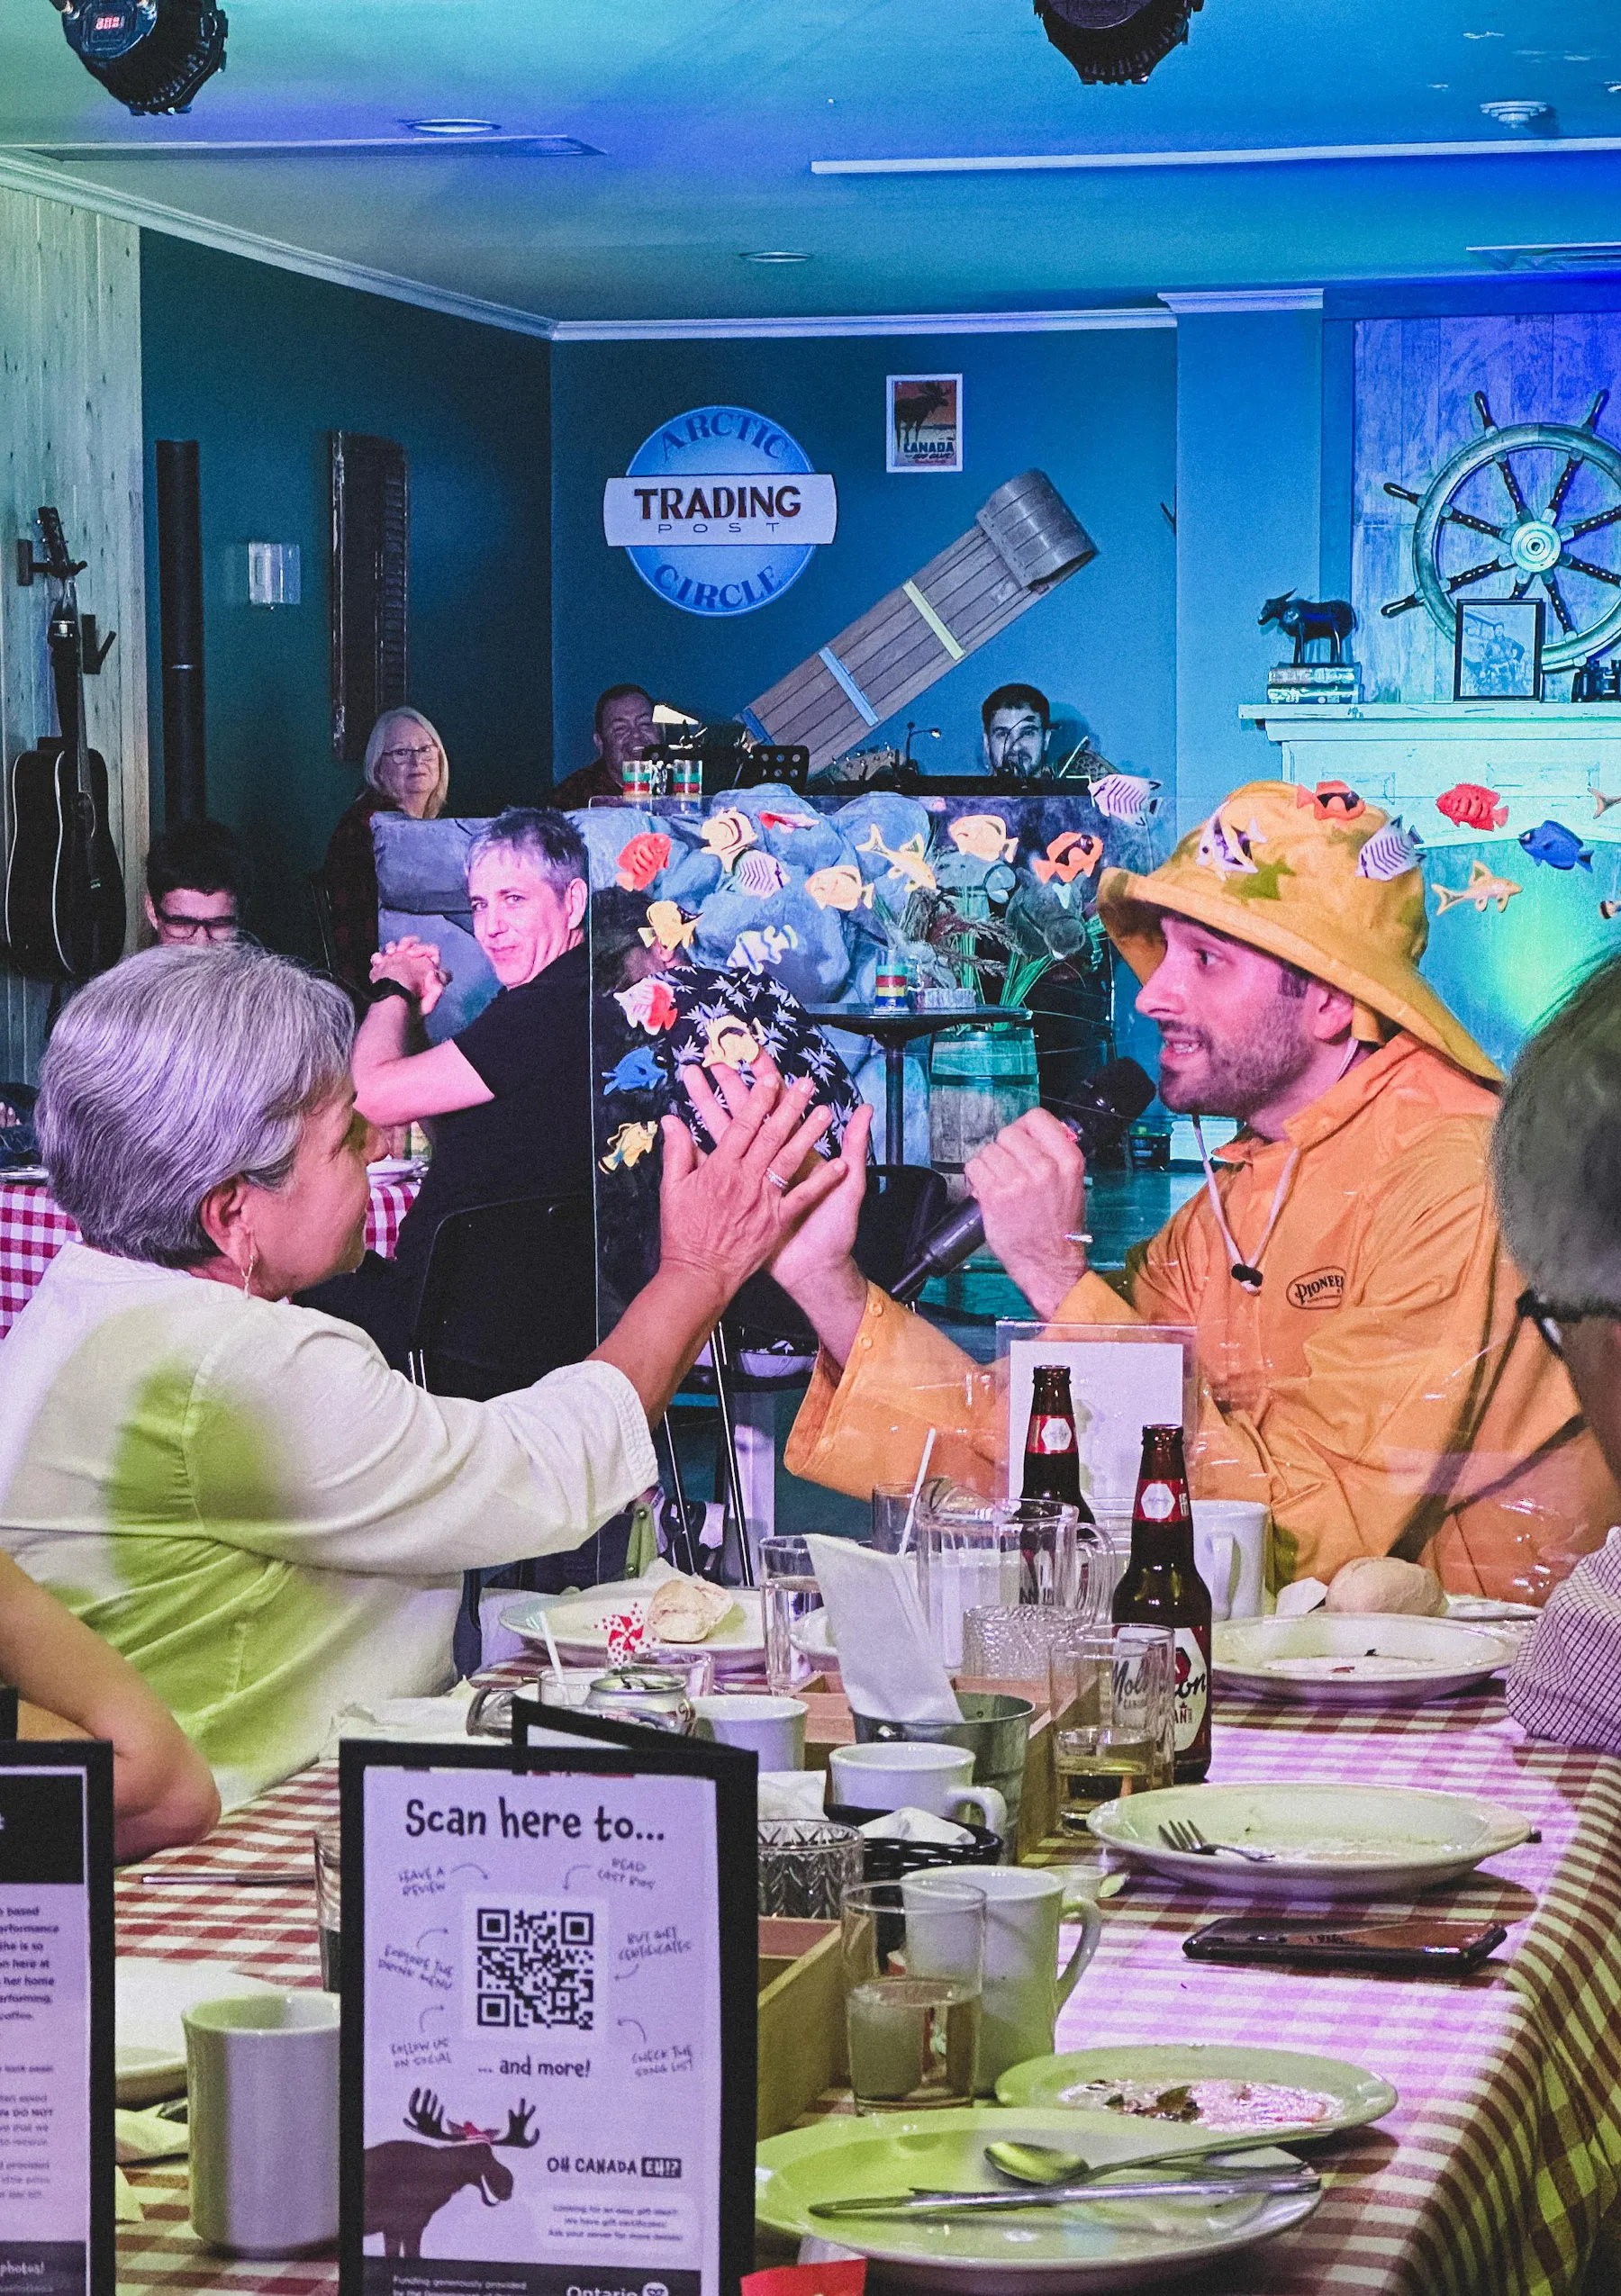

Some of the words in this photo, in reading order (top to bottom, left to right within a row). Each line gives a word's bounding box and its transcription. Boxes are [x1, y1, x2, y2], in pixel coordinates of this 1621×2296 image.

[662, 411, 790, 463] ARCTIC
[634, 485, 801, 520] TRADING
[657, 522, 780, 534] POST
[654, 564, 782, 610] CIRCLE
[405, 1798, 487, 1838] Scan
[498, 1795, 582, 1840] here
[594, 1804, 665, 1843] to...
[499, 2053, 531, 2077] and
[539, 2058, 592, 2079] more!
[547, 2156, 570, 2173] OH
[575, 2157, 638, 2174] CANADA
